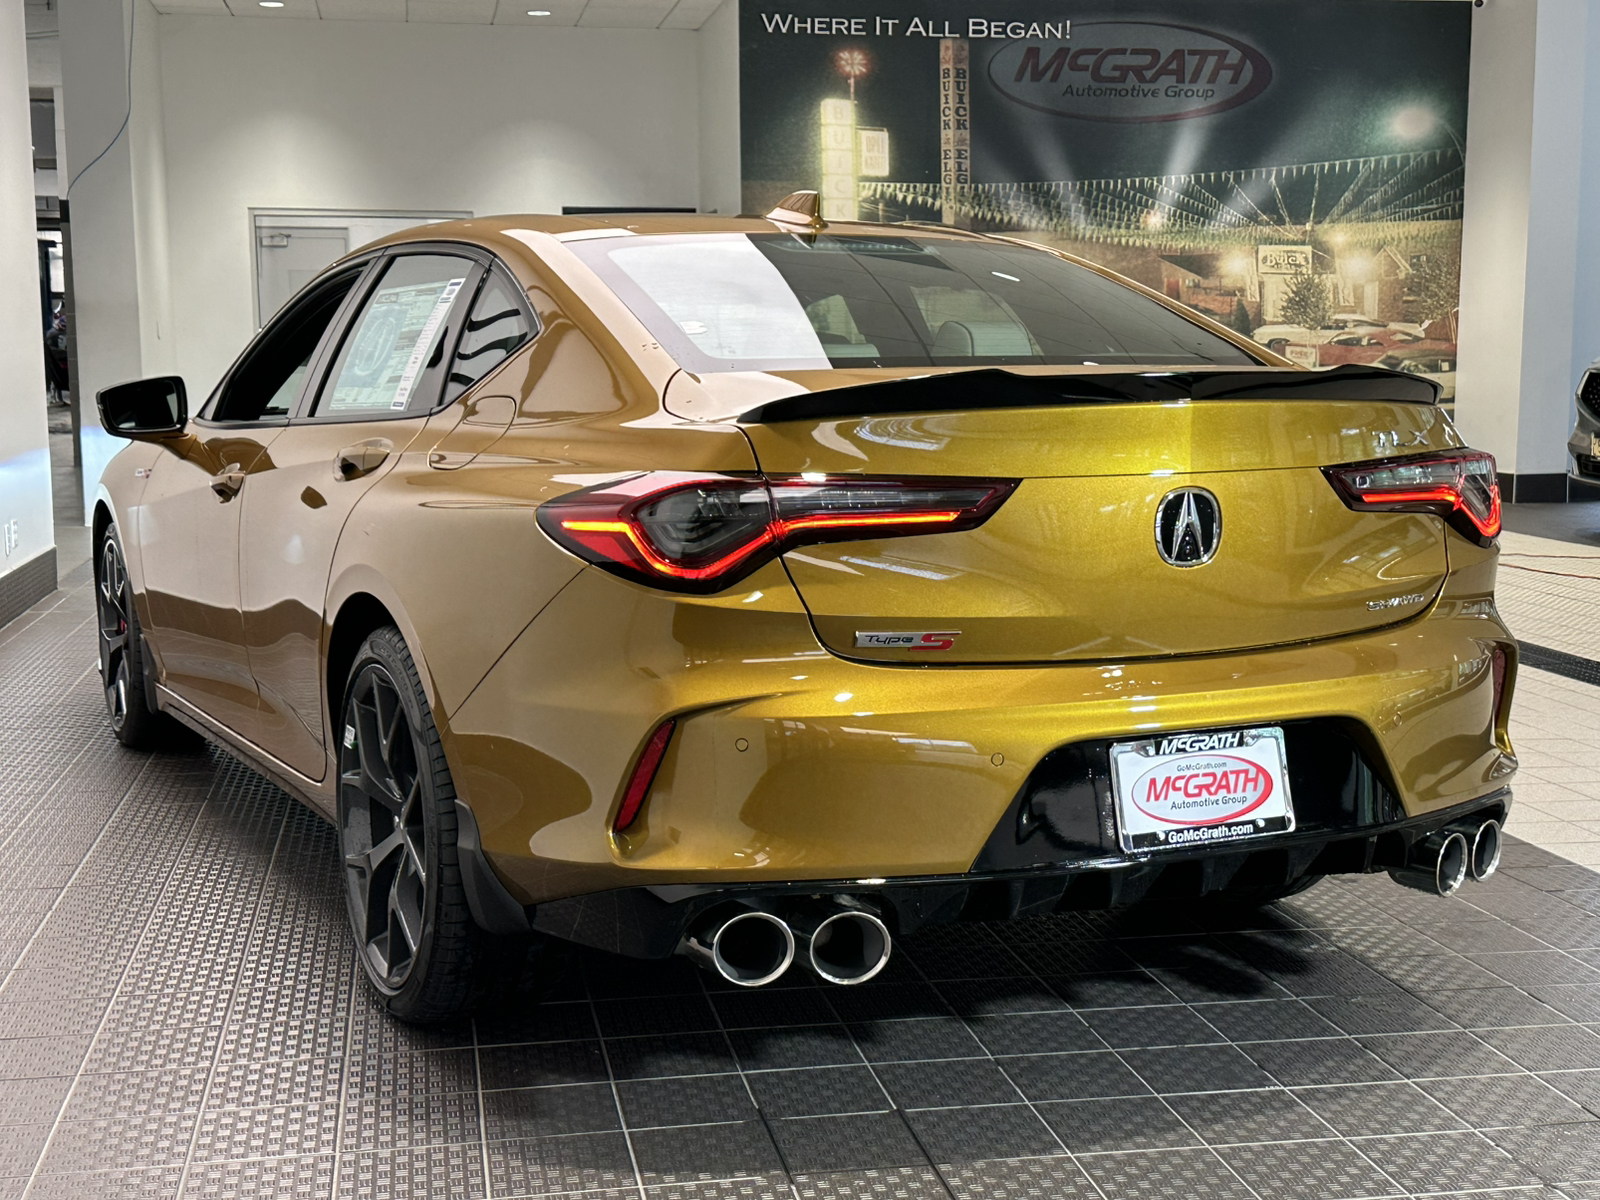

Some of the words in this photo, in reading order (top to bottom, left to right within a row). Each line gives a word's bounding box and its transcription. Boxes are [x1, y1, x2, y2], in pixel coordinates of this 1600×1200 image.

[942, 67, 952, 131] BUICK
[954, 67, 969, 131] BUICK
[1062, 84, 1160, 99] Automotive
[1164, 85, 1215, 101] Group
[864, 634, 914, 645] Type
[908, 631, 961, 652] S
[1176, 761, 1228, 772] GoMcGrath.com
[1170, 797, 1220, 810] Automotive
[1221, 794, 1248, 806] Group
[1167, 823, 1254, 844] GoMcGrath.com
